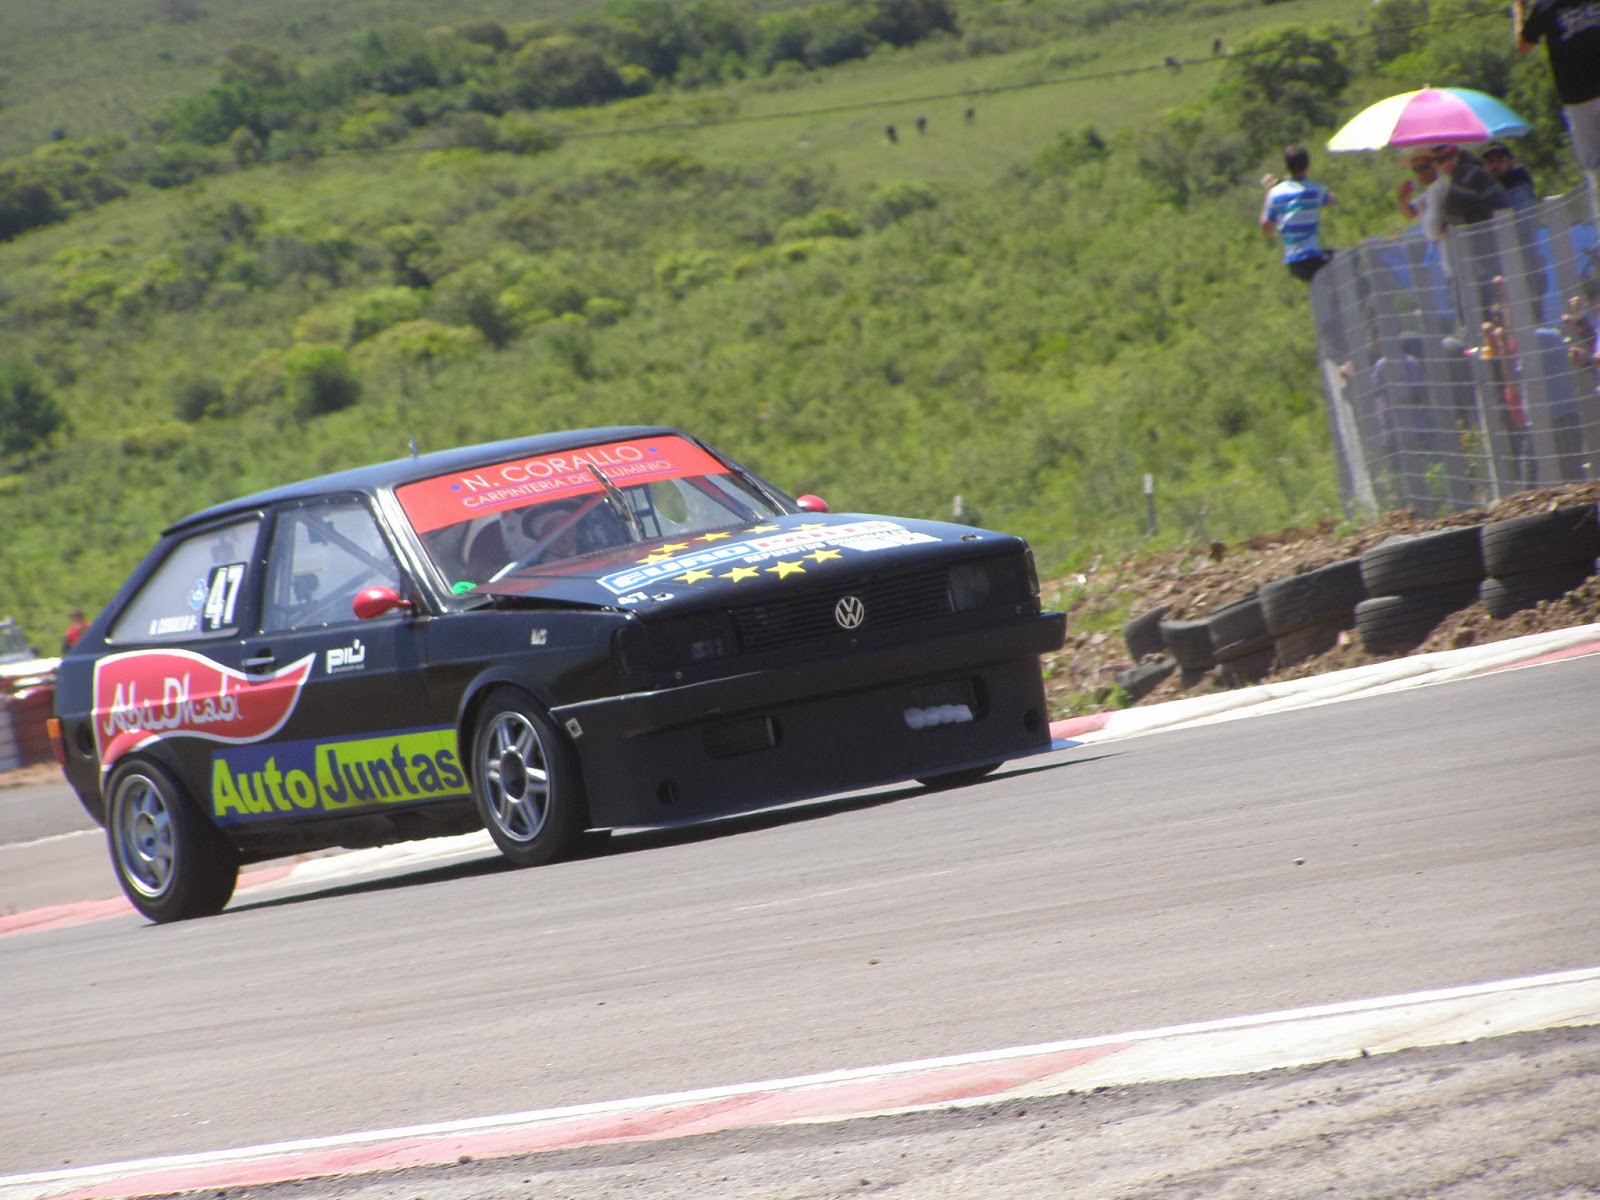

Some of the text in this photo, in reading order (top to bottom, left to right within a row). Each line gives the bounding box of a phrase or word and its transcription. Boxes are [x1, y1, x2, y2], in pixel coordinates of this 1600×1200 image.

[461, 445, 643, 491] N. CORALLO
[463, 460, 671, 507] CARPINTERIA DE LUMINIO
[205, 564, 245, 629] 47
